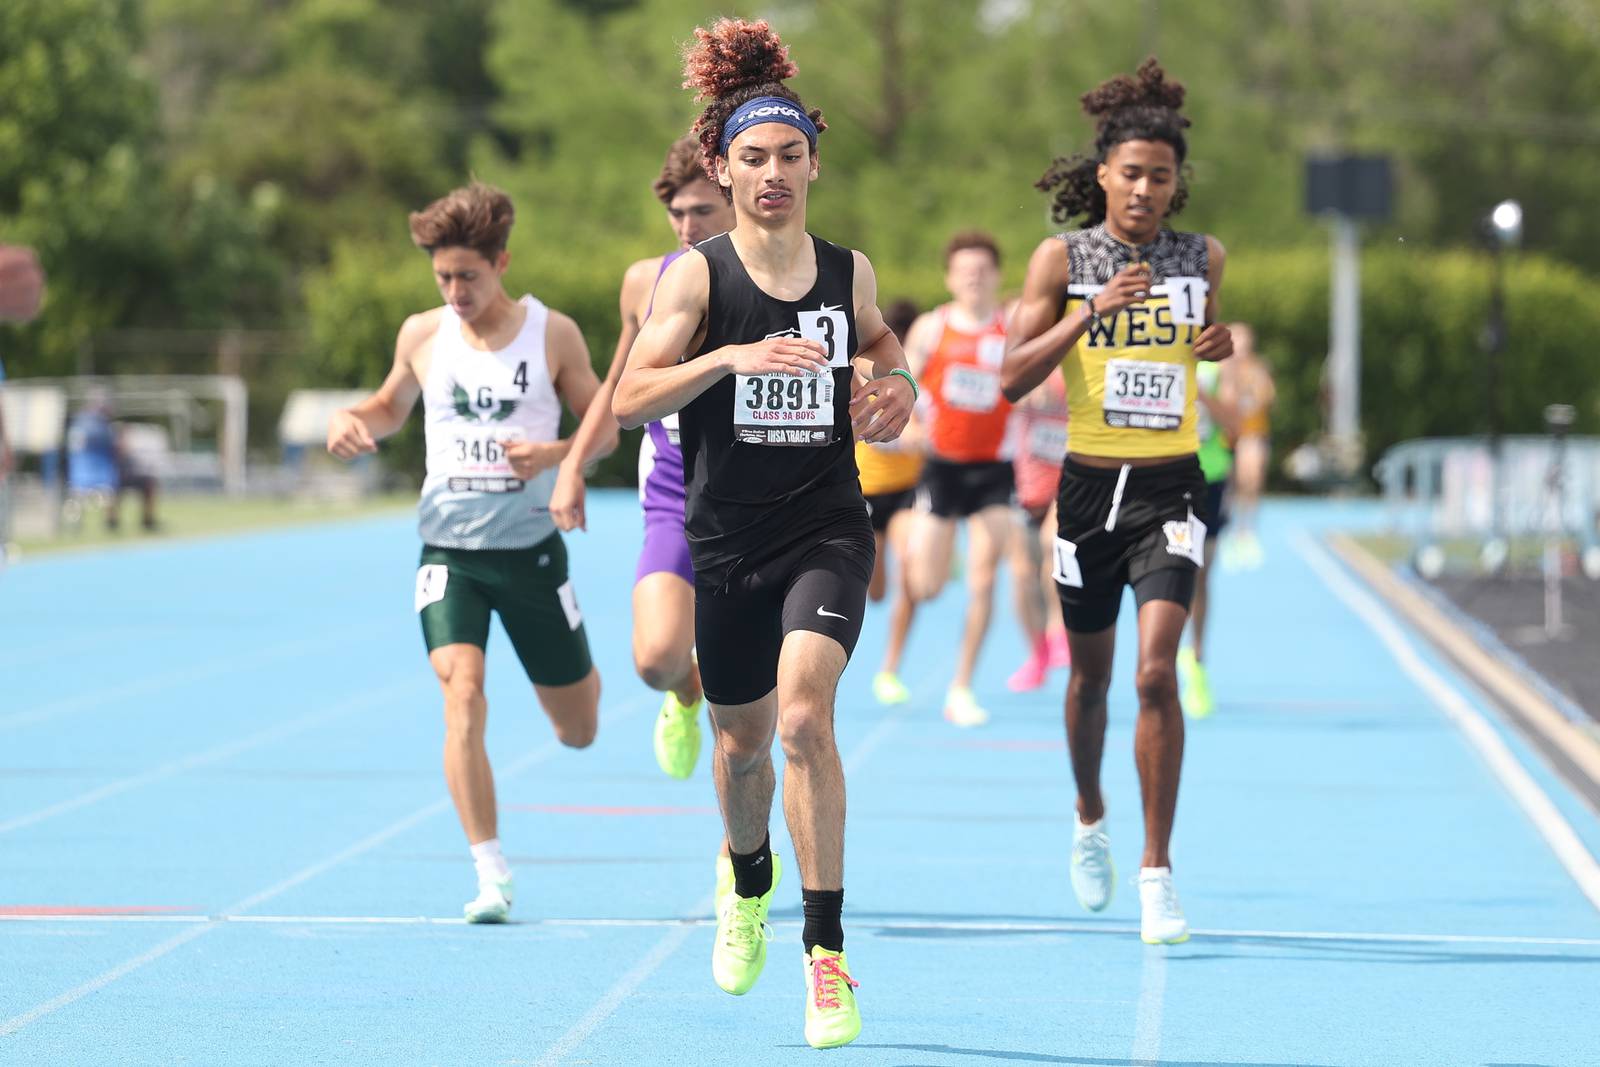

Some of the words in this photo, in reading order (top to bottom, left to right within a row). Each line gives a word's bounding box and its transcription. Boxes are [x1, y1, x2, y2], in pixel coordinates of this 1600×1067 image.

[1183, 283, 1195, 318] 1
[816, 316, 835, 362] 3
[513, 361, 529, 393] 4
[1116, 371, 1175, 399] 3557
[477, 387, 493, 409] G
[746, 377, 820, 410] 3891
[752, 410, 780, 420] CLASS
[782, 412, 793, 420] 3A
[795, 411, 816, 420] BOYS
[785, 429, 811, 443] TRACK
